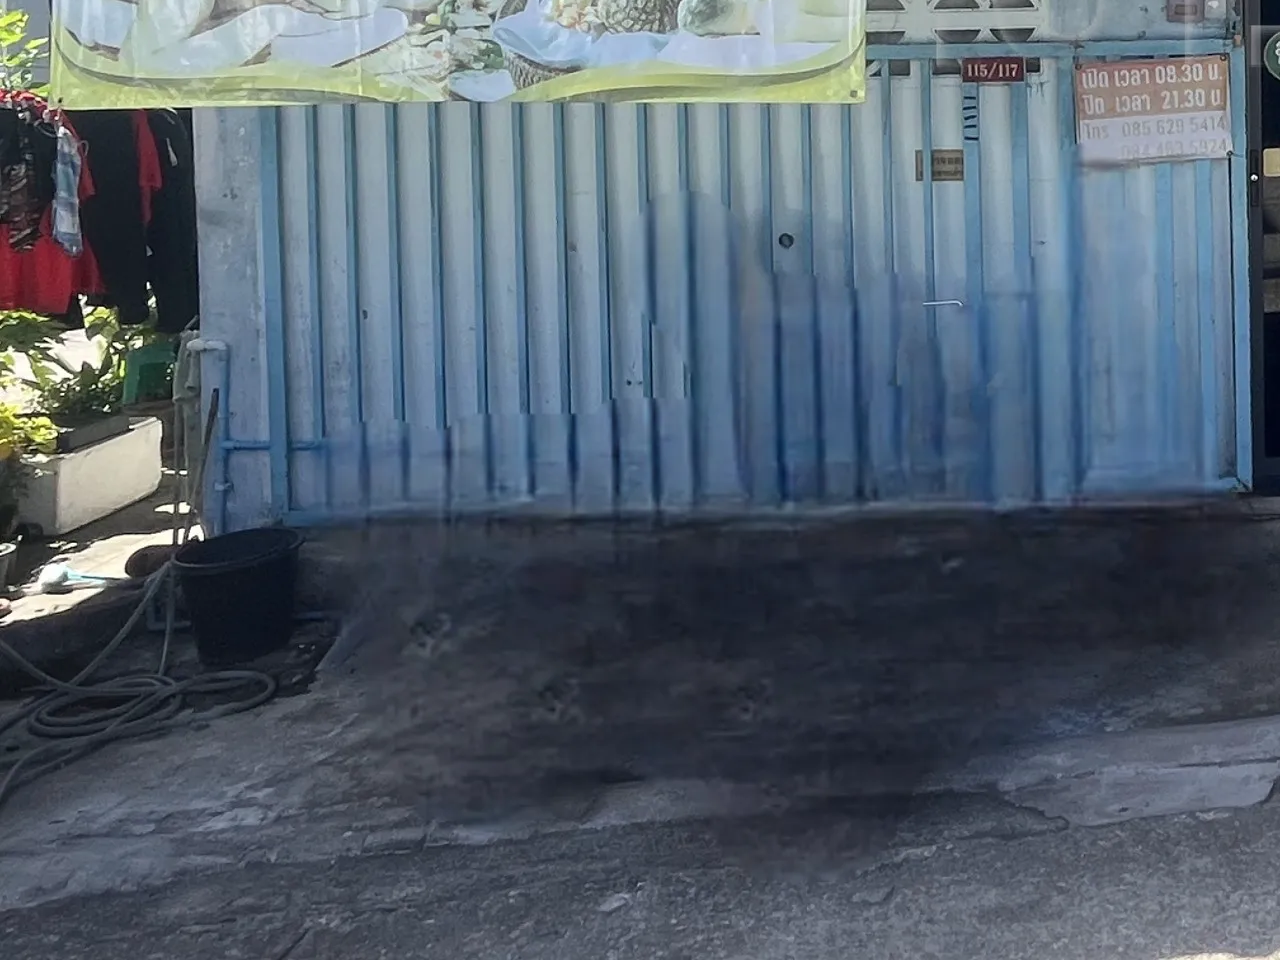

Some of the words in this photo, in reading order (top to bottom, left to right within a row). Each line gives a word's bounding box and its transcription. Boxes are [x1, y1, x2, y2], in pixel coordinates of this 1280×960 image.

[966, 62, 1019, 79] 115/117
[1081, 66, 1109, 89] เปิด
[1114, 65, 1151, 88] เวลา
[1155, 63, 1203, 84] 08.30
[1208, 63, 1223, 82] น.
[1082, 93, 1105, 115] ปิด
[1115, 93, 1151, 114] เวลา
[1161, 89, 1205, 111] 21.30
